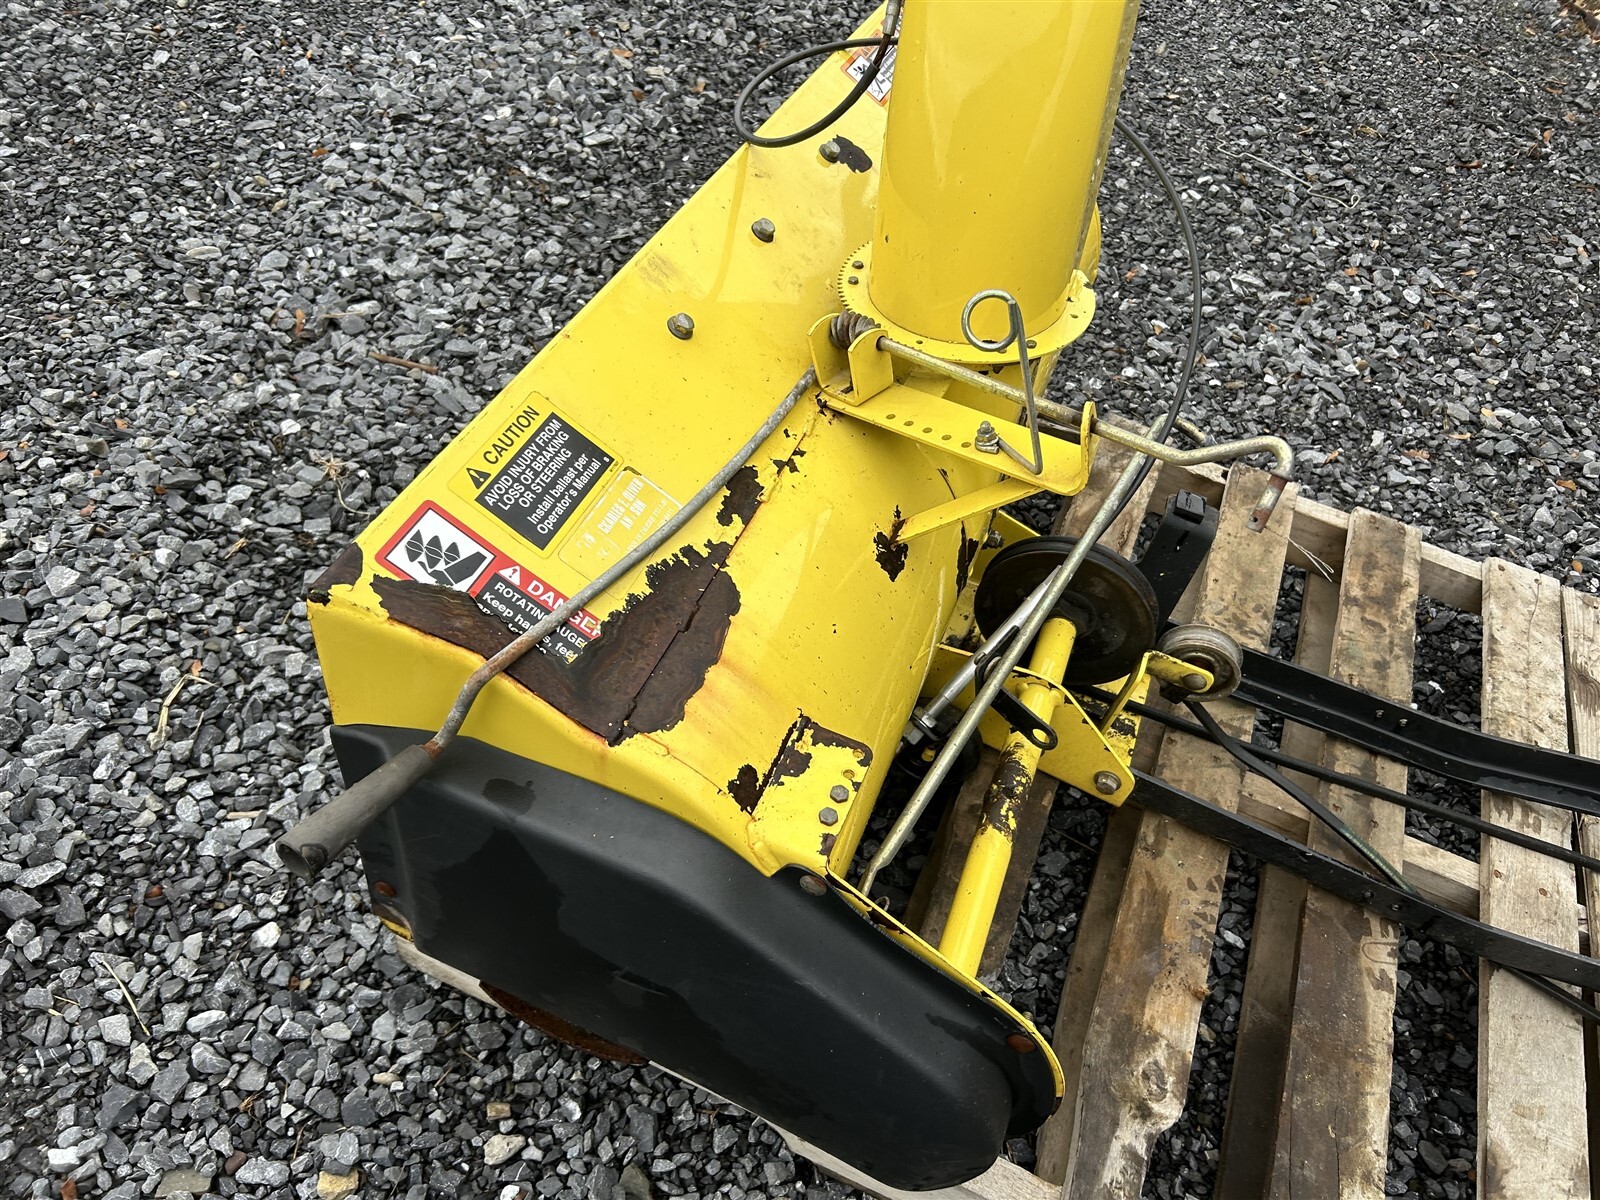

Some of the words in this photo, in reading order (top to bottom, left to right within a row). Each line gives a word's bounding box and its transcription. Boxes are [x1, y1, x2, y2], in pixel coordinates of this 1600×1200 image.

[483, 406, 540, 464] CAUTION
[484, 475, 513, 506] AVOID
[510, 443, 540, 478] INJURY
[538, 419, 562, 447] FROM
[498, 485, 525, 511] LOSS
[521, 468, 535, 485] OF
[532, 431, 569, 472] BRAKING
[518, 492, 536, 508] OR
[535, 449, 572, 494] STEERING
[527, 497, 554, 524] Install
[553, 467, 579, 500] ballast
[574, 454, 588, 474] per
[537, 490, 578, 534] Operator's
[573, 460, 601, 496] Manual
[483, 592, 514, 624] Keep
[514, 614, 552, 647] has,
